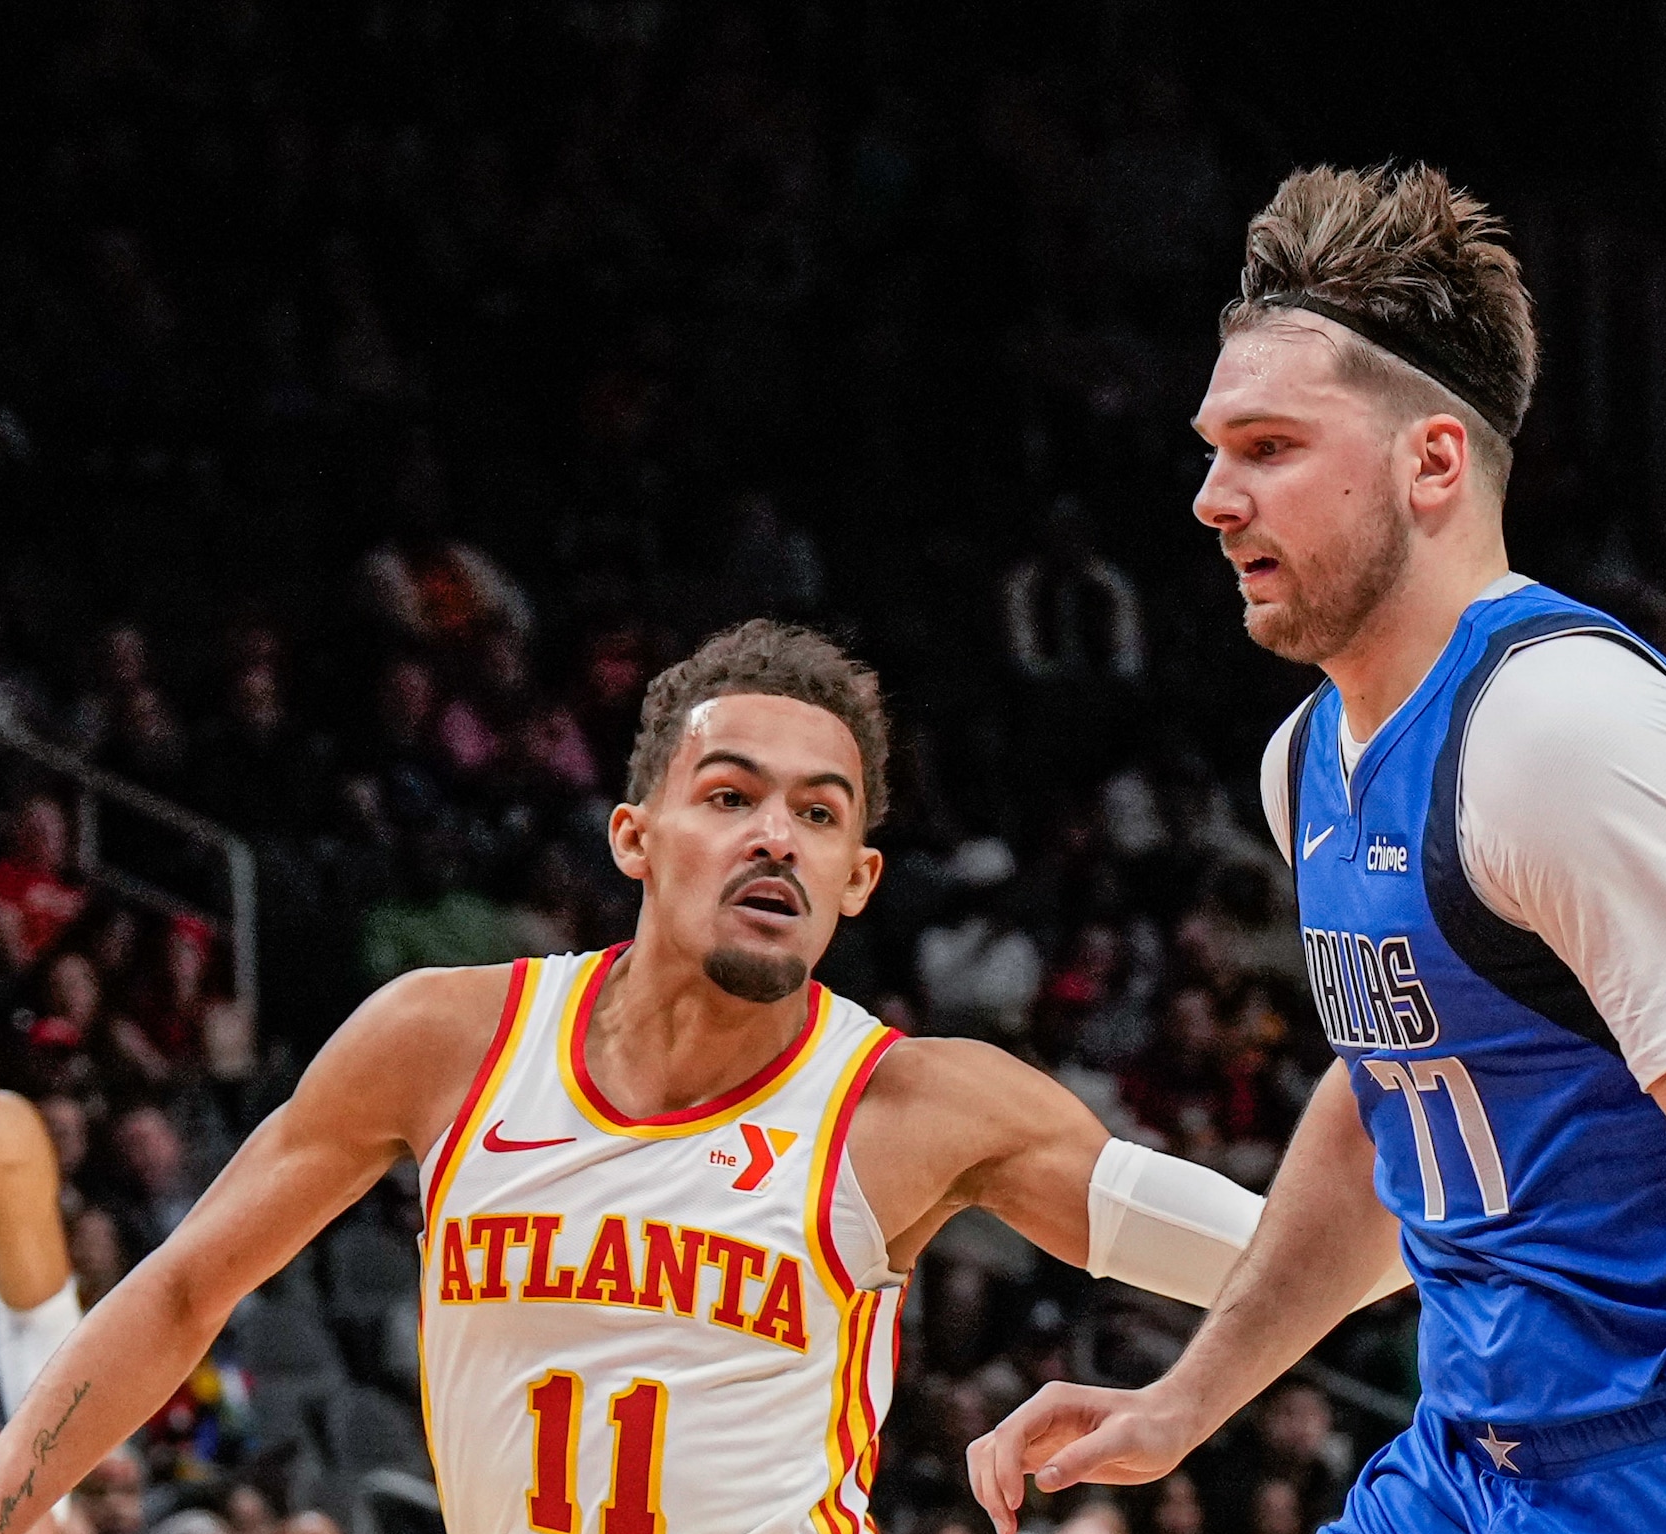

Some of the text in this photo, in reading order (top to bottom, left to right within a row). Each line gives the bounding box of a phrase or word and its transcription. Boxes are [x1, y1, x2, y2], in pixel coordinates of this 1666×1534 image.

[1366, 835, 1408, 874] chime
[1304, 926, 1440, 1050] DALLAS
[710, 1150, 737, 1167] the
[1361, 1056, 1510, 1221] 77
[439, 1213, 811, 1355] ATLANTA
